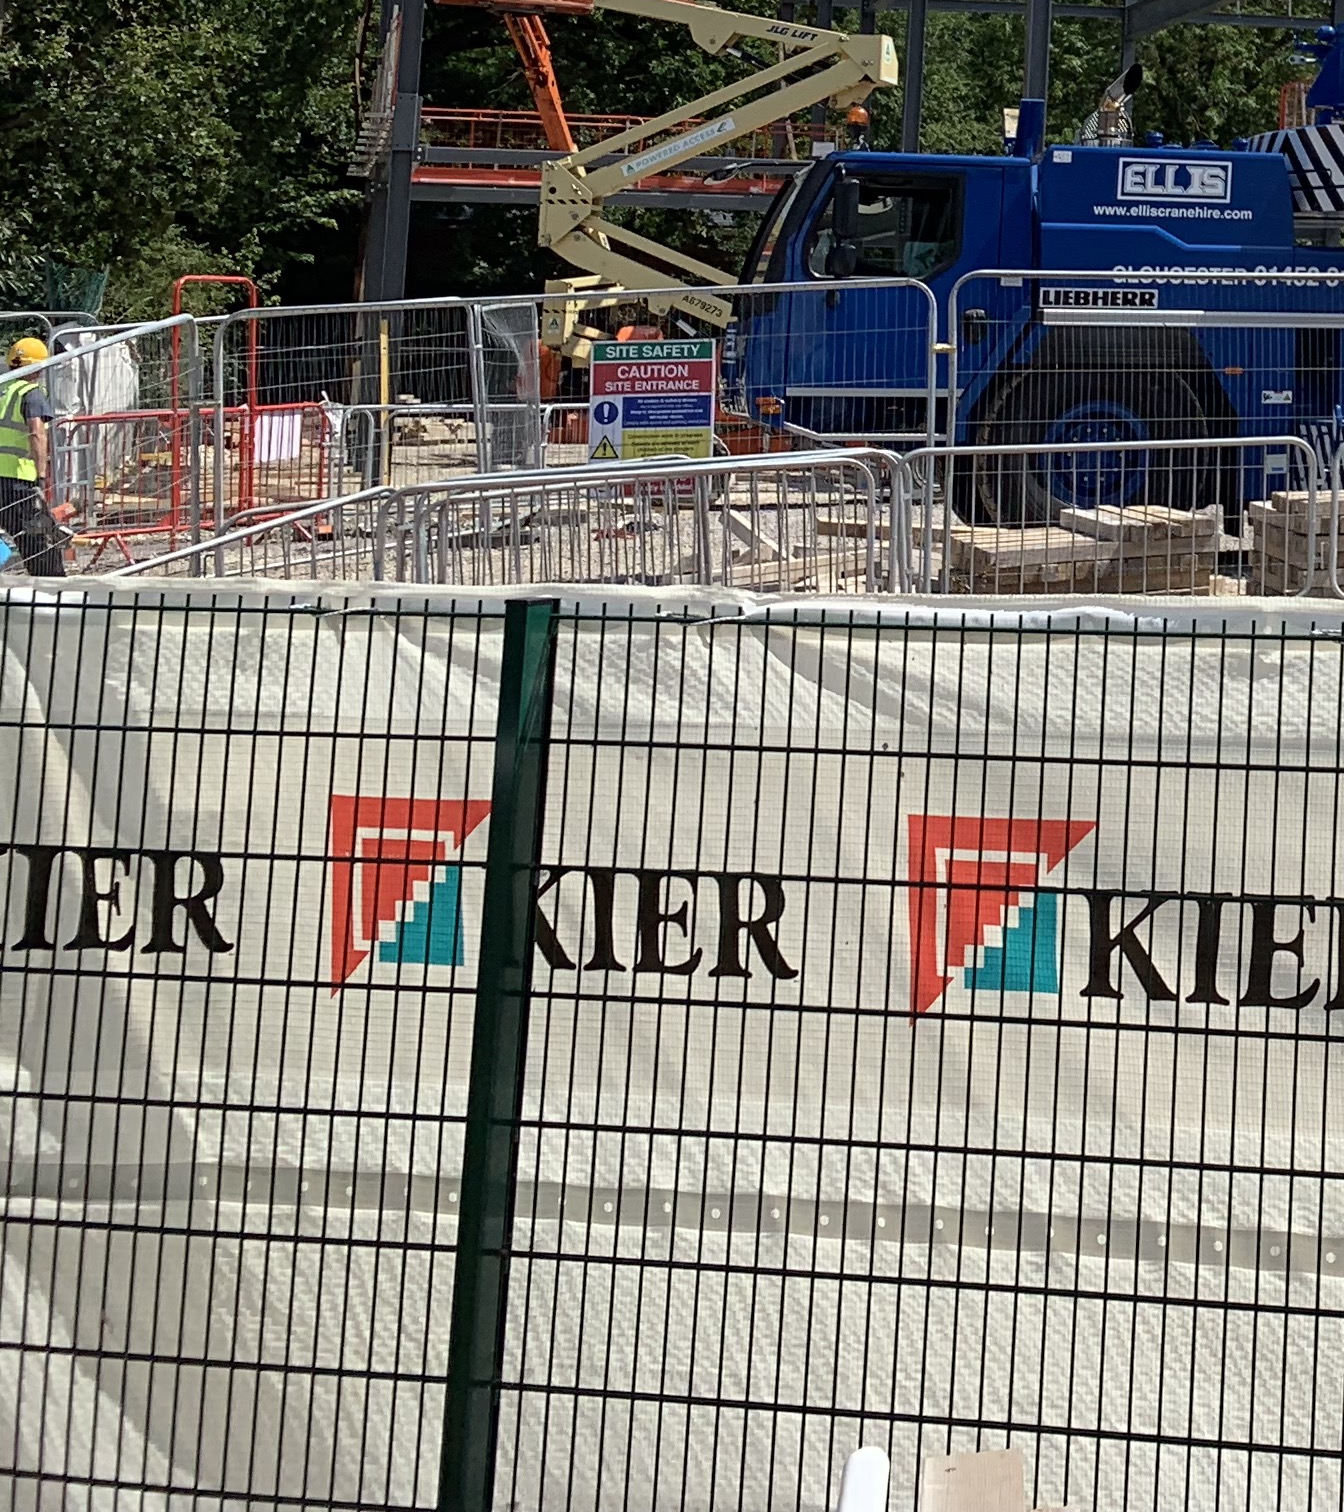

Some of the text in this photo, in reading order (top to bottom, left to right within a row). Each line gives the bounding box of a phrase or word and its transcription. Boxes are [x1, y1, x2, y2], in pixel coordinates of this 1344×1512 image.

[766, 25, 818, 42] JLG LIFT
[635, 144, 681, 167] POWERED
[682, 128, 716, 149] ACCESS
[1123, 163, 1227, 197] ELLIS
[1093, 204, 1253, 220] www.elliscranehire.com
[681, 295, 724, 318] A679273
[1041, 289, 1157, 308] LIEBHERR
[605, 344, 700, 359] SITE SAFETY
[617, 364, 690, 379] CAUTION
[604, 380, 700, 392] SITE ENTRANCE
[0, 845, 235, 954] IER
